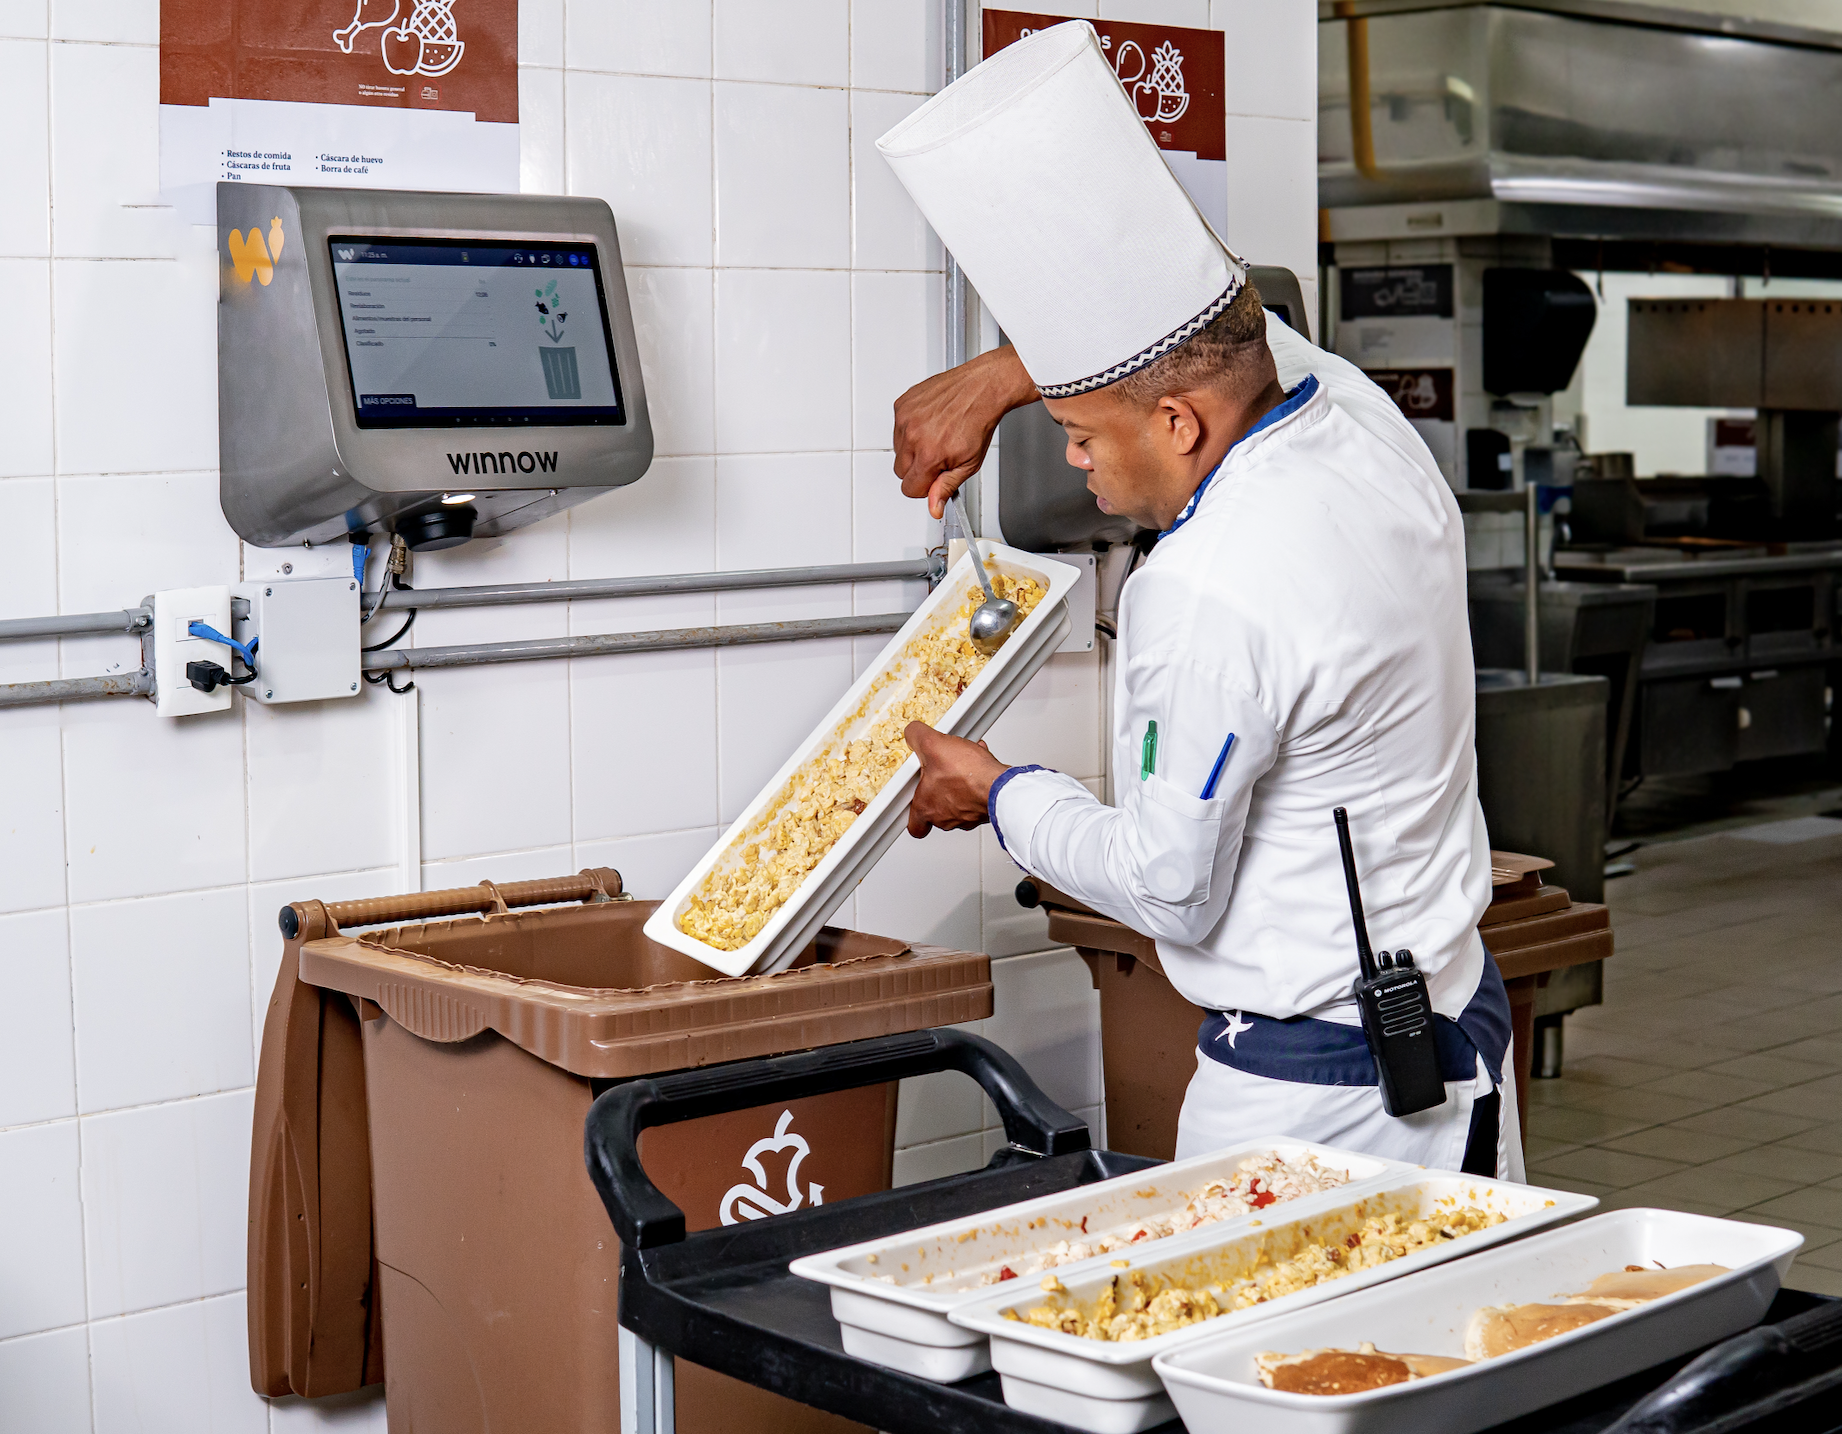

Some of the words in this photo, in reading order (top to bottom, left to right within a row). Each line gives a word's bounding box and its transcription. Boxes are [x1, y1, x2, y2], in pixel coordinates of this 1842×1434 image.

[227, 149, 252, 158] Restos
[253, 150, 263, 159] de
[264, 151, 292, 160] comida
[320, 153, 350, 162] Cáscara
[351, 154, 360, 163] de
[361, 155, 384, 164] huevo
[226, 160, 260, 170] Cáscaras
[261, 162, 271, 170] de
[272, 162, 291, 171] fruta
[321, 164, 342, 173] Borra
[343, 165, 352, 173] de
[353, 165, 369, 174] café
[227, 171, 242, 180] Pan
[380, 396, 414, 405] OPCIONES
[1383, 979, 1418, 994] MOTOROLA
